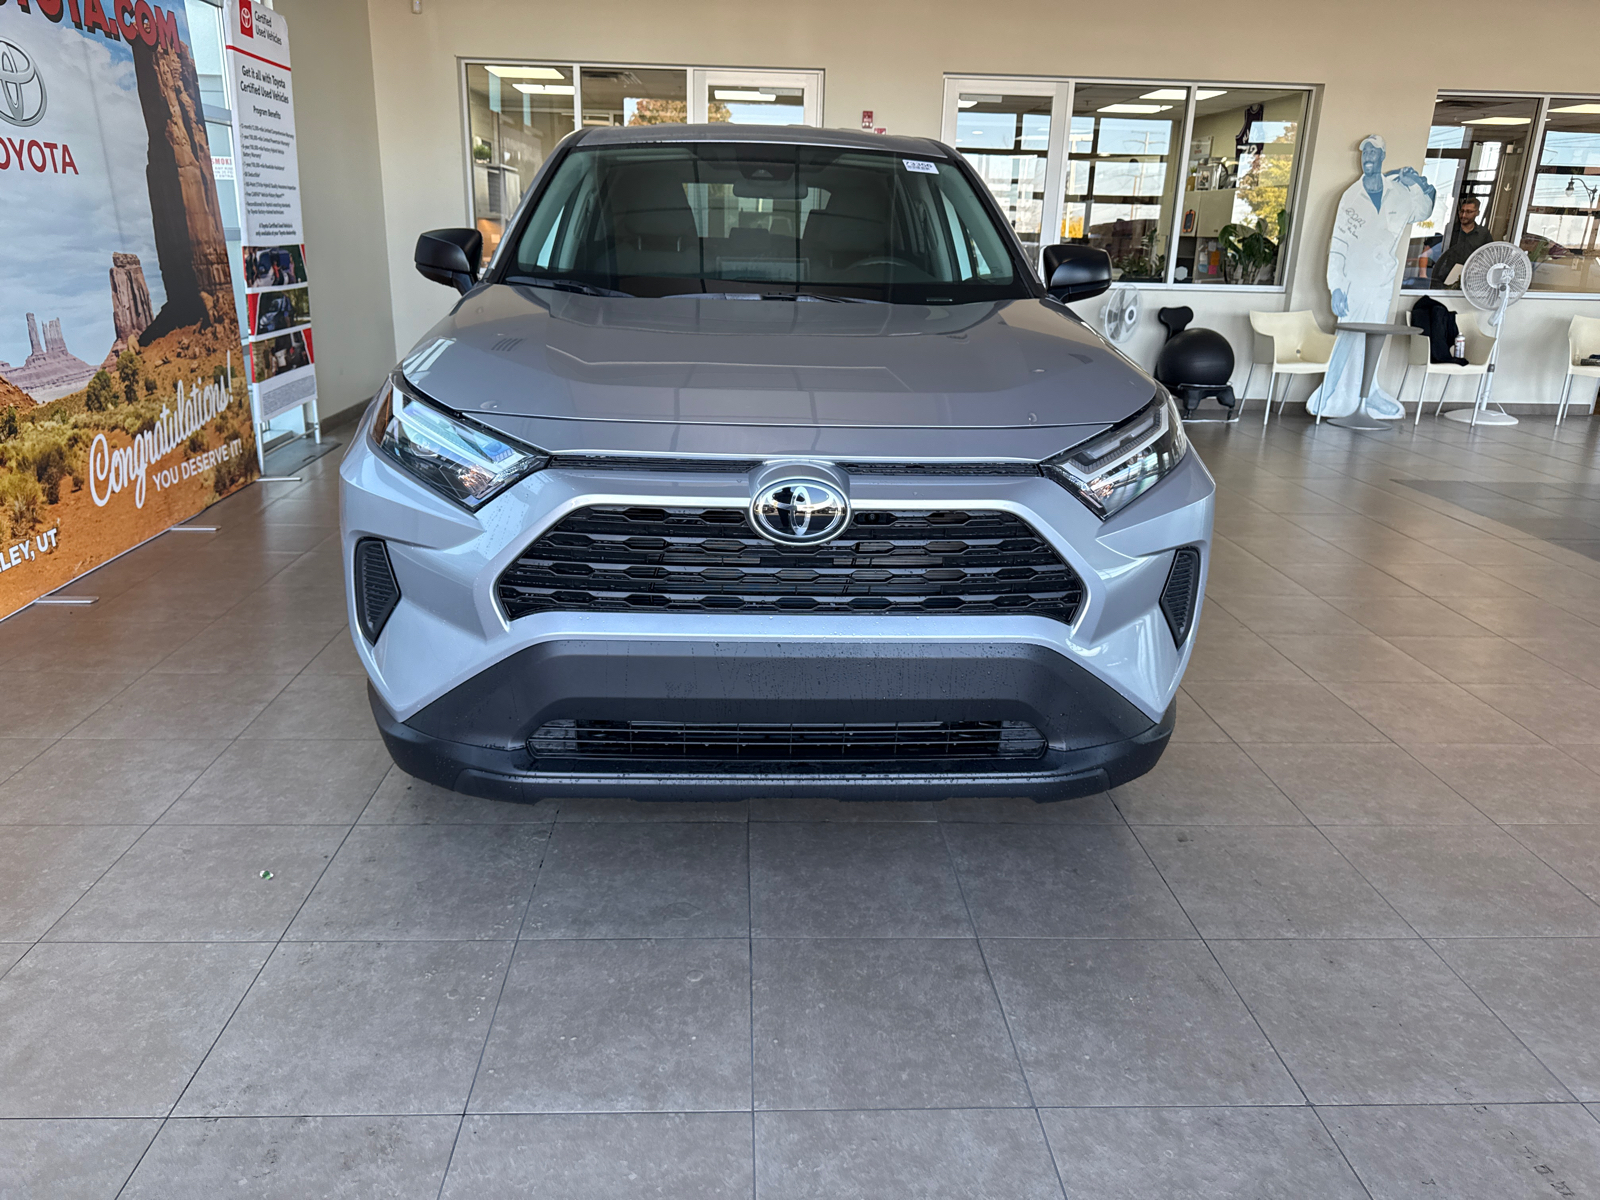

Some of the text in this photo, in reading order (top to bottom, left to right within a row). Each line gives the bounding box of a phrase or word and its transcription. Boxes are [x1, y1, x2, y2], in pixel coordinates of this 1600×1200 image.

[254, 10, 272, 28] Certified
[255, 24, 282, 46] Used Vehicles
[241, 65, 251, 78] Get
[262, 72, 272, 85] with
[271, 74, 286, 90] Toyota
[240, 80, 289, 104] Certified Used Vehicles
[89, 349, 234, 510] Congratulations!
[152, 437, 243, 492] YOU DESERVE IT!
[0, 527, 57, 573] LEY, UT
